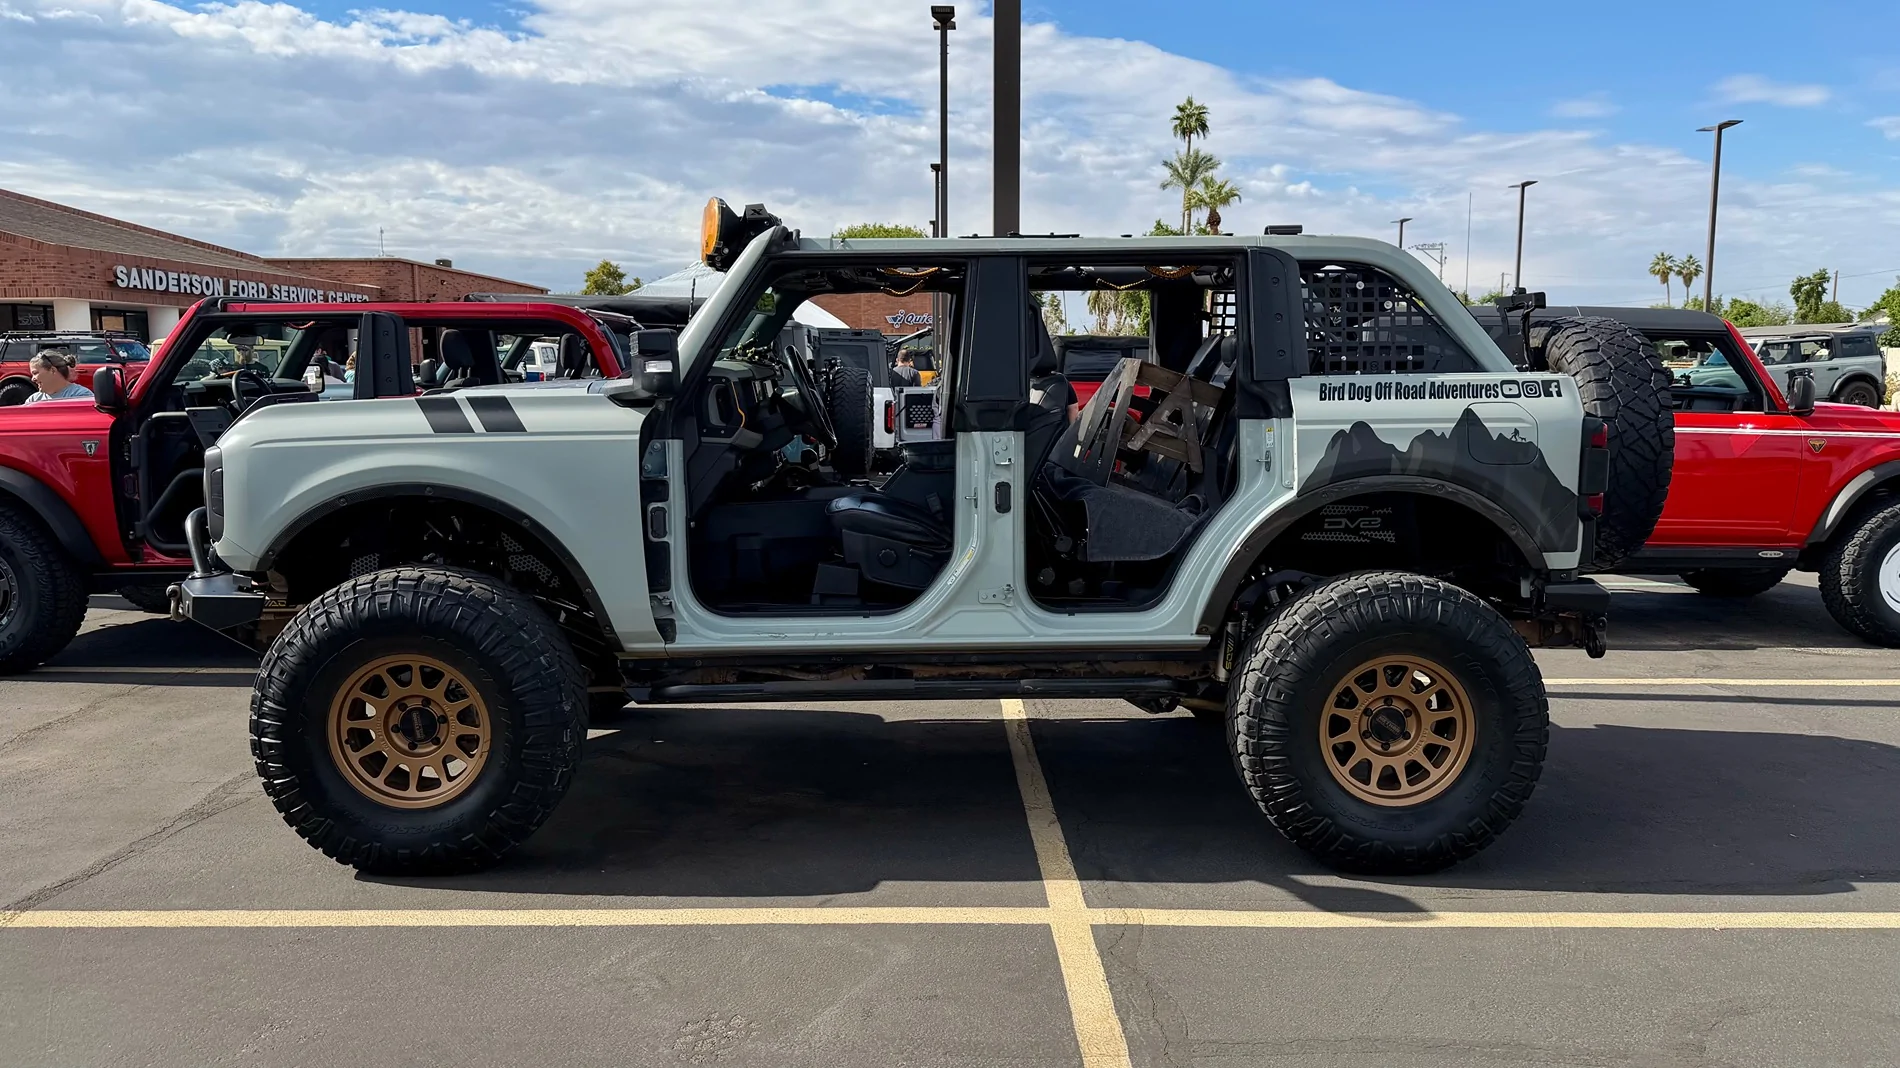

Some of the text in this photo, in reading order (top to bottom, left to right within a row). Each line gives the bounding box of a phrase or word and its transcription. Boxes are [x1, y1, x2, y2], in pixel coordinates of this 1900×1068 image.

[116, 265, 223, 296] SANDERSON
[229, 279, 268, 299] FORD
[272, 284, 324, 303] SERVICE
[904, 312, 933, 325] Quic
[1319, 381, 1500, 403] Bird Dog Off Road Adventures
